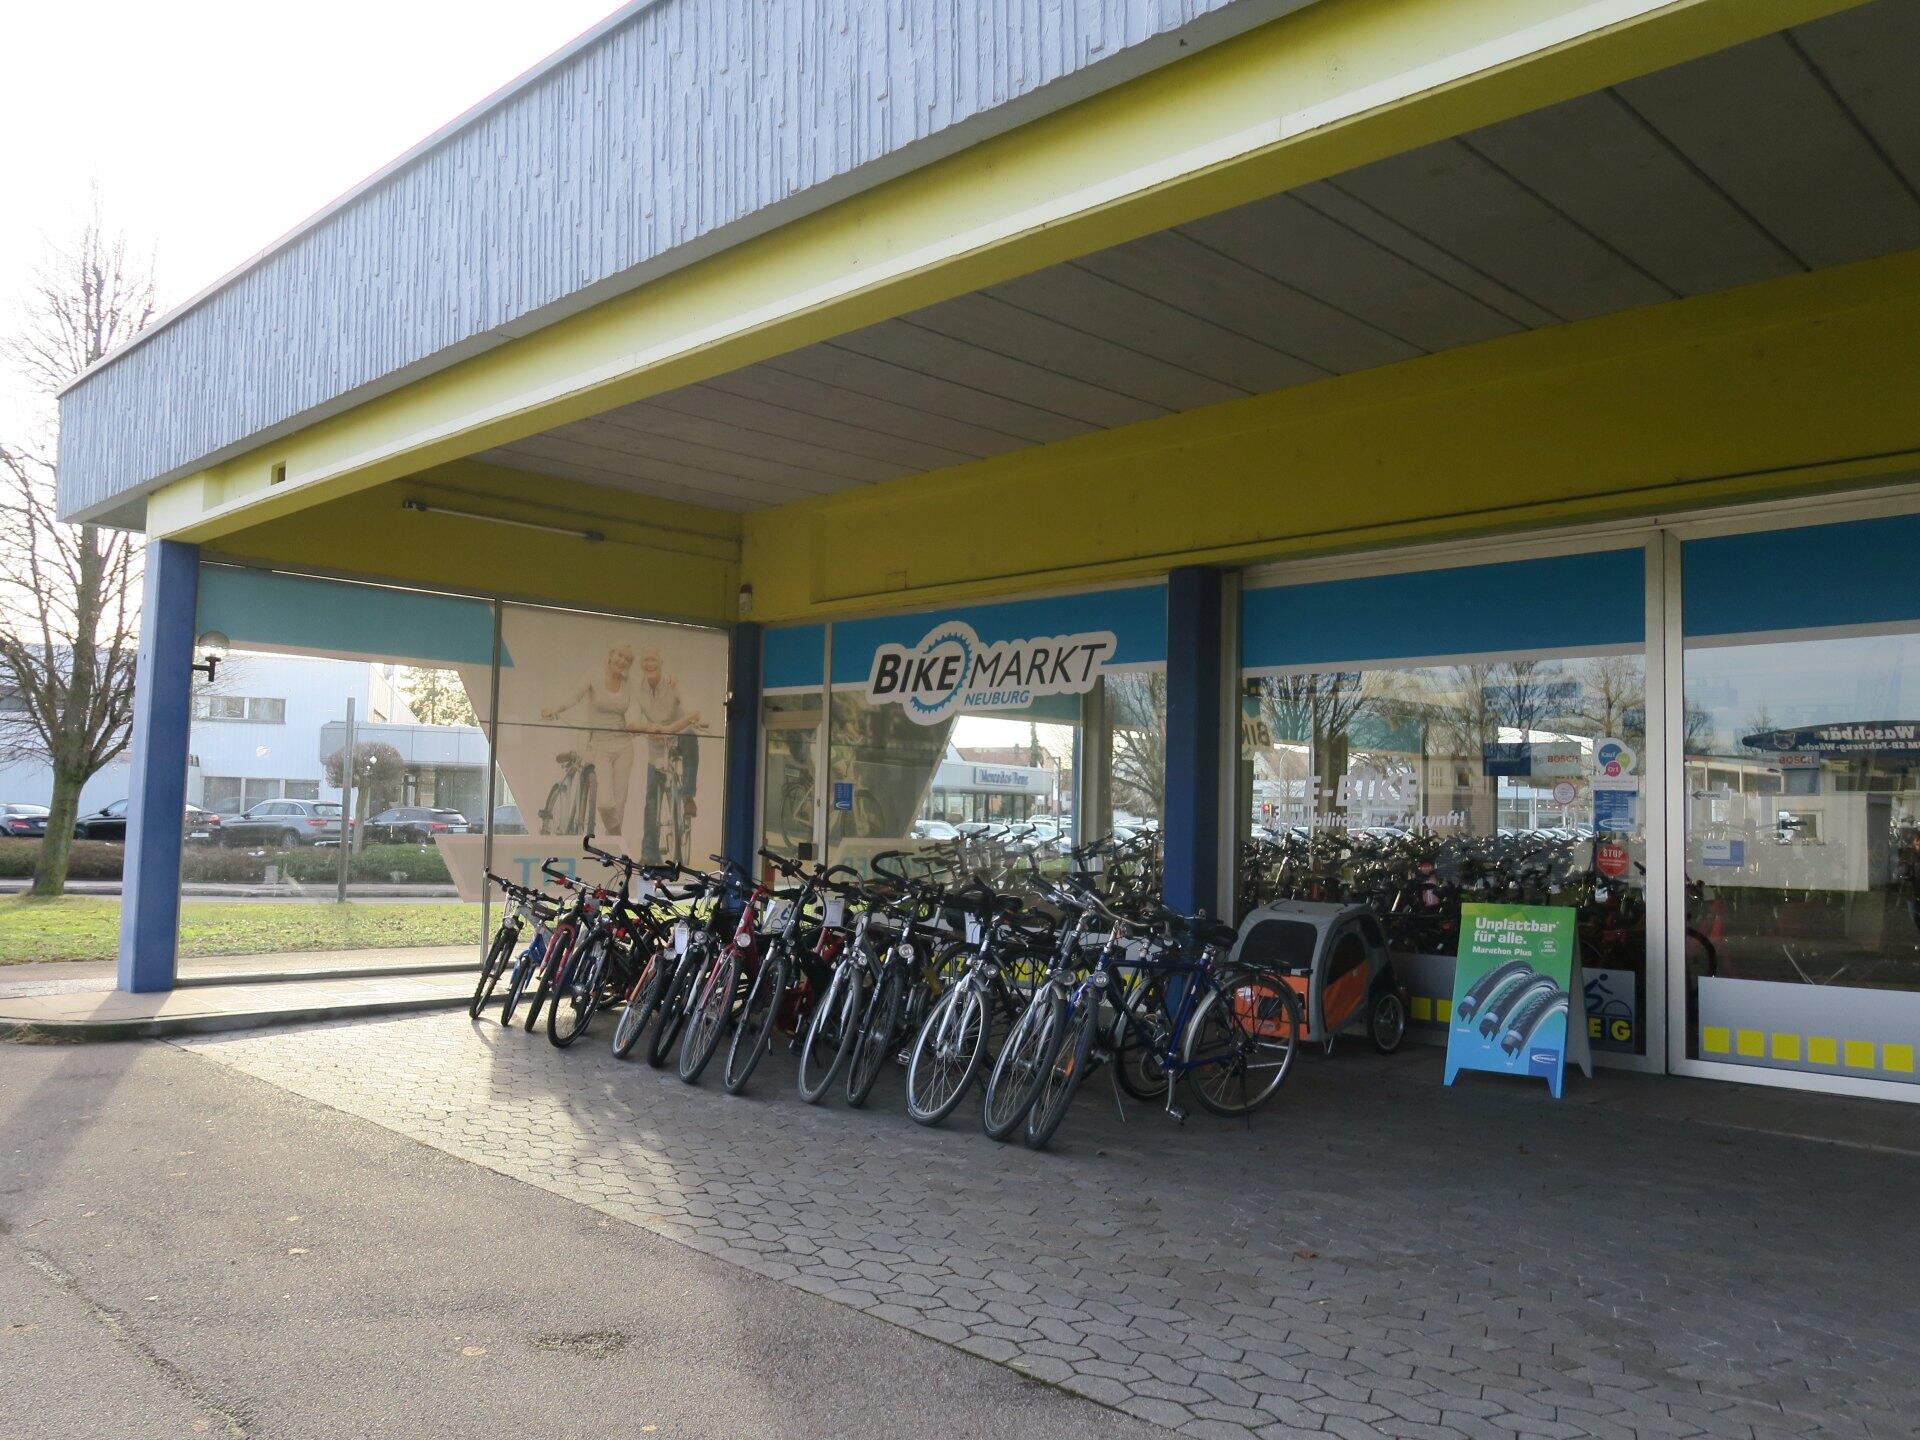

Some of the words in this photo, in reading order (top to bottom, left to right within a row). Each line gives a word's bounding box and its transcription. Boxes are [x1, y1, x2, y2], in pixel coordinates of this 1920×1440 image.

[873, 653, 962, 695] BIKE
[968, 642, 1107, 690] MARKT
[964, 690, 1031, 707] NEUBURG
[1302, 773, 1419, 807] E-BIKE
[1602, 848, 1624, 858] STOP
[1473, 930, 1496, 942] für
[1498, 932, 1527, 944] alle.
[1472, 946, 1512, 955] Marathon
[1514, 948, 1532, 957] Plus
